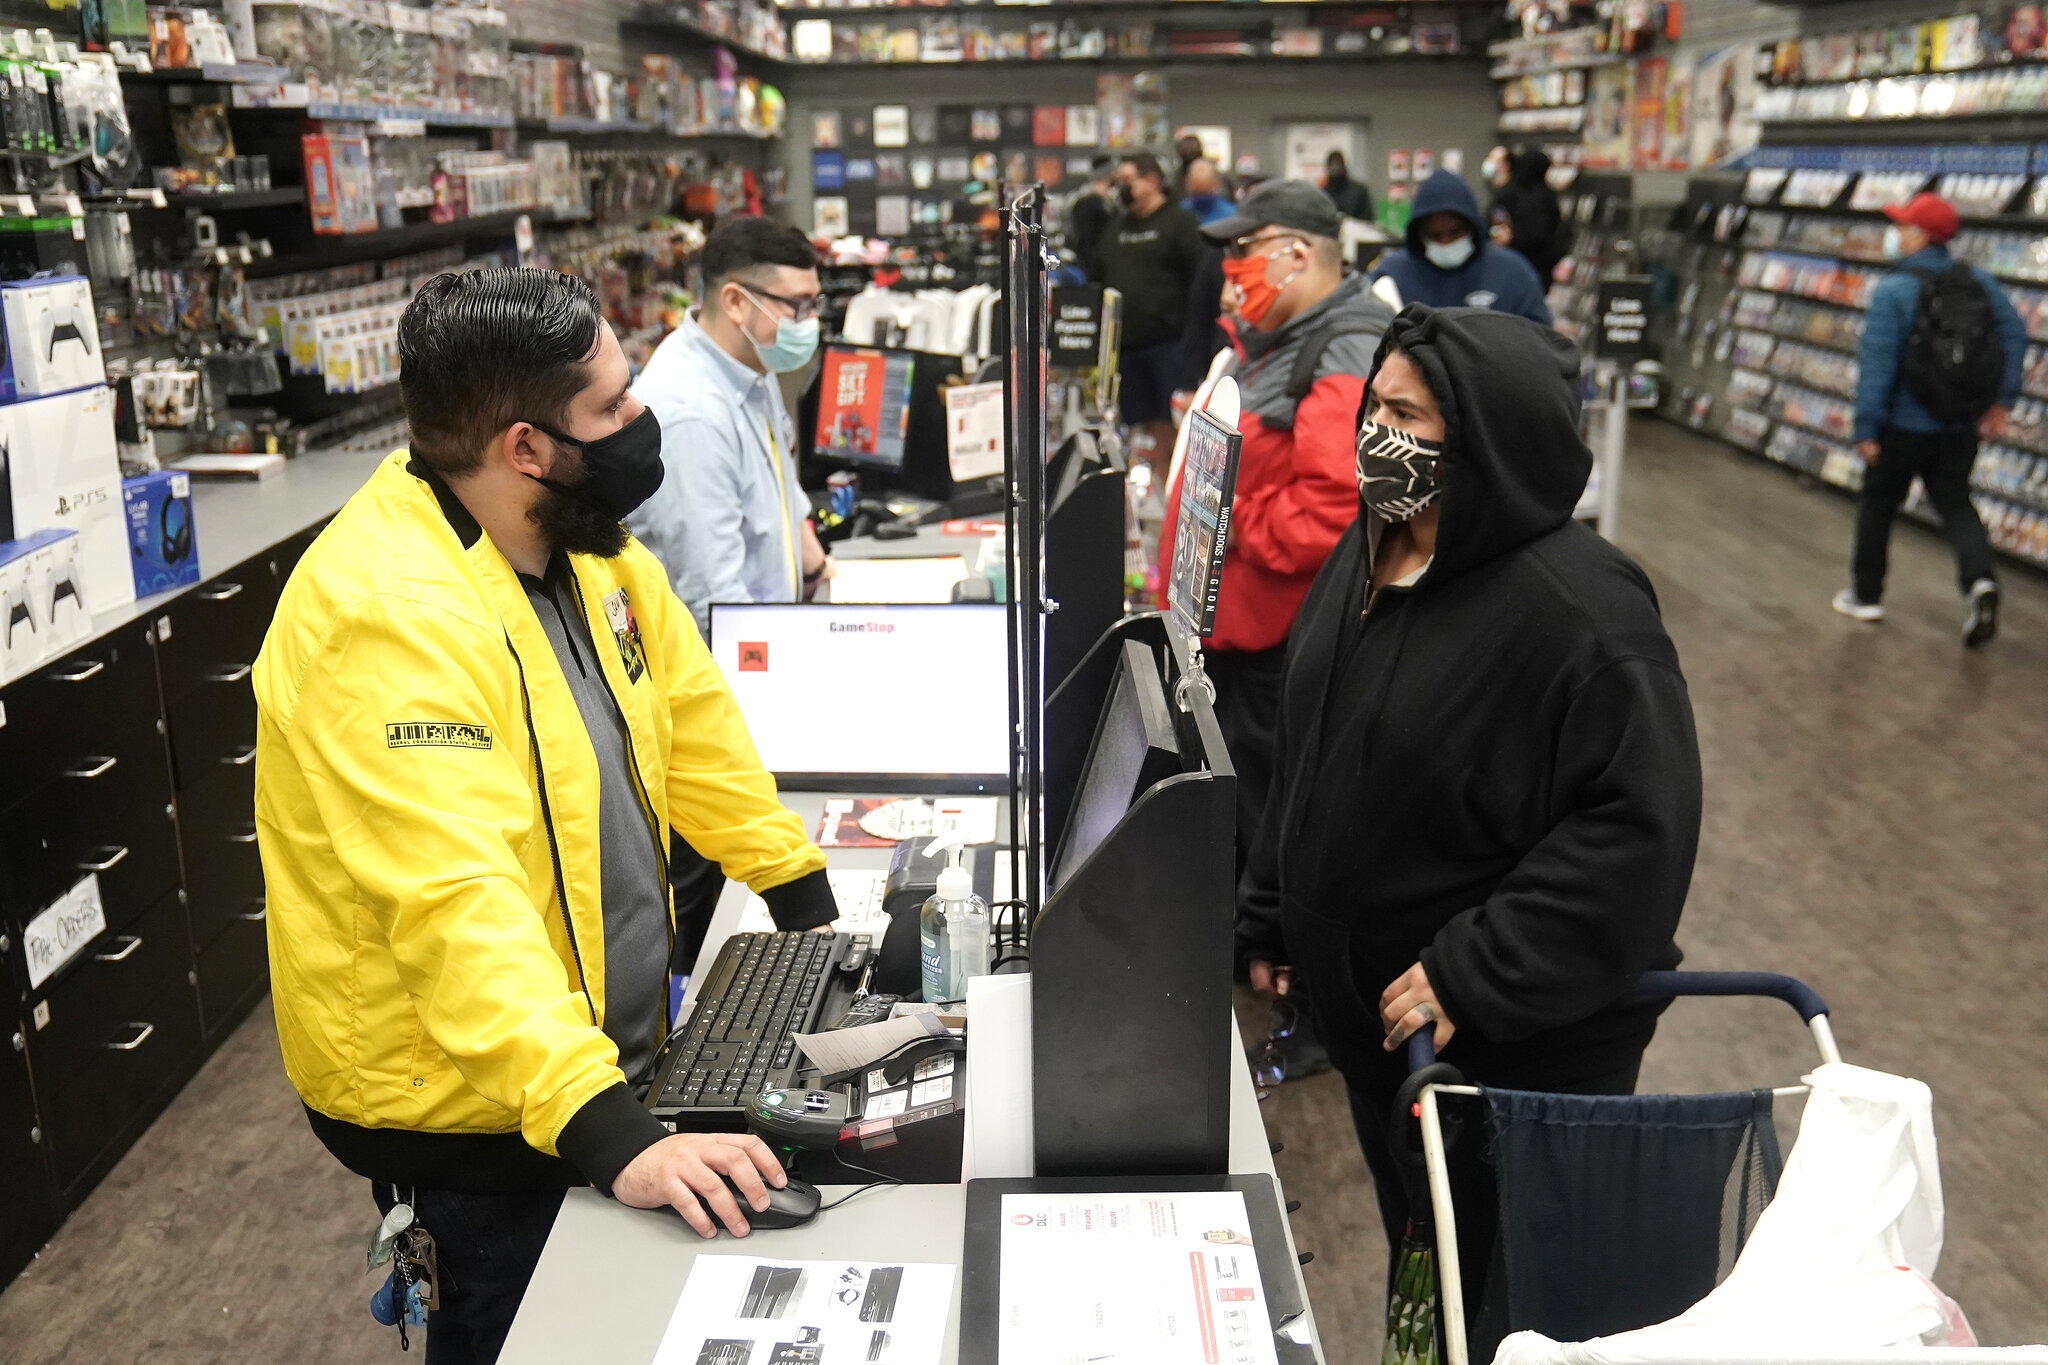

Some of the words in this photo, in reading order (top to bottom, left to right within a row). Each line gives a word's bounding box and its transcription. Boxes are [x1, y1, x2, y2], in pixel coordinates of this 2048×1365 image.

[73, 486, 108, 511] PS5
[1217, 506, 1230, 534] WATCH
[1214, 534, 1226, 557] DOGS
[829, 622, 895, 634] GameStop
[921, 951, 941, 967] and
[1036, 1212, 1047, 1227] DLC
